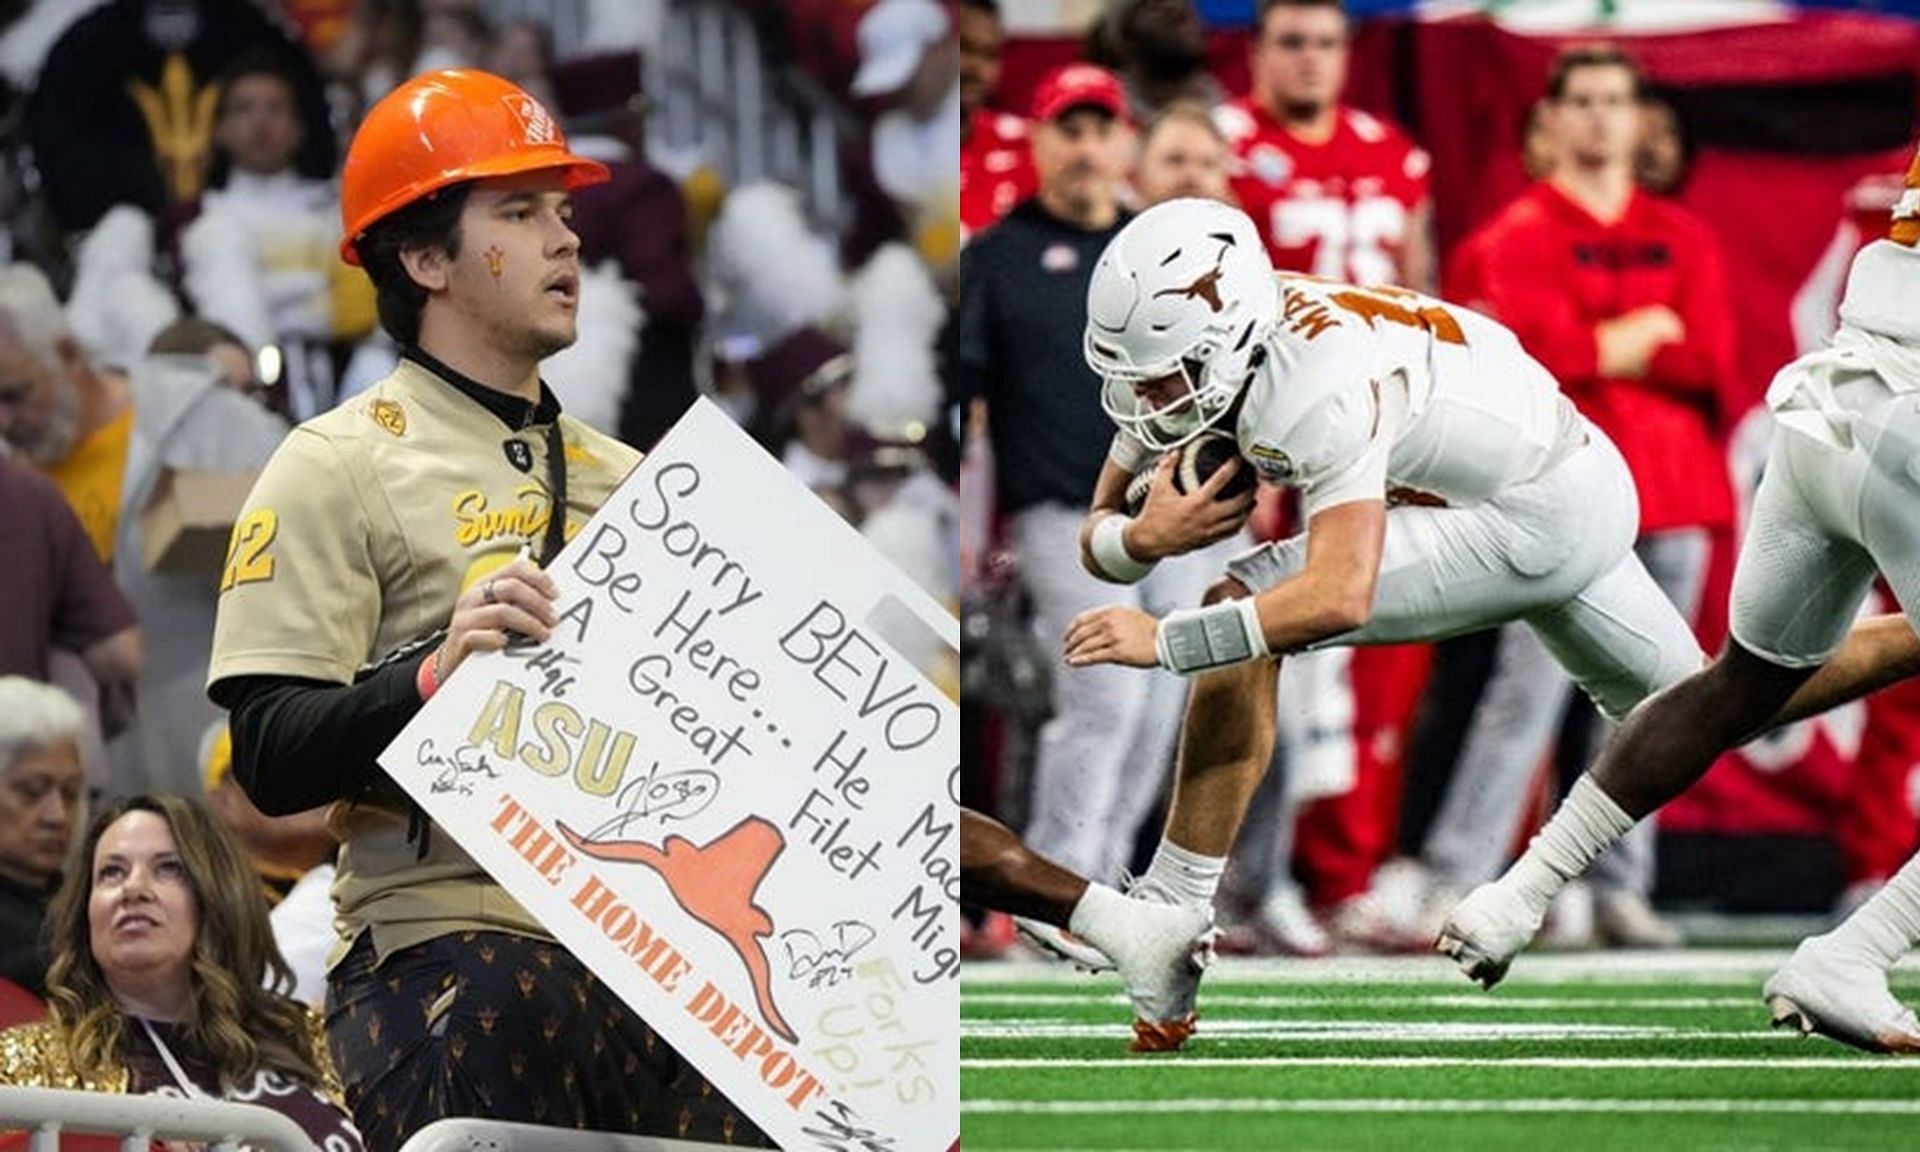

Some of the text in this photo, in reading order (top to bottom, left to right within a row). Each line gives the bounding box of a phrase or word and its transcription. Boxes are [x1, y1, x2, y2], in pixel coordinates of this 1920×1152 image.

[467, 680, 638, 798] ASU
[572, 523, 642, 613] Be
[813, 729, 870, 811] He
[630, 462, 941, 750] Sorry BEVO
[558, 596, 594, 643] A
[628, 654, 753, 765] Great
[789, 788, 880, 880] Filet
[891, 885, 960, 984] Mig
[488, 793, 579, 887] THE
[570, 872, 696, 995] HOME
[684, 980, 829, 1113] DEPOT
[856, 956, 940, 1105] Forks
